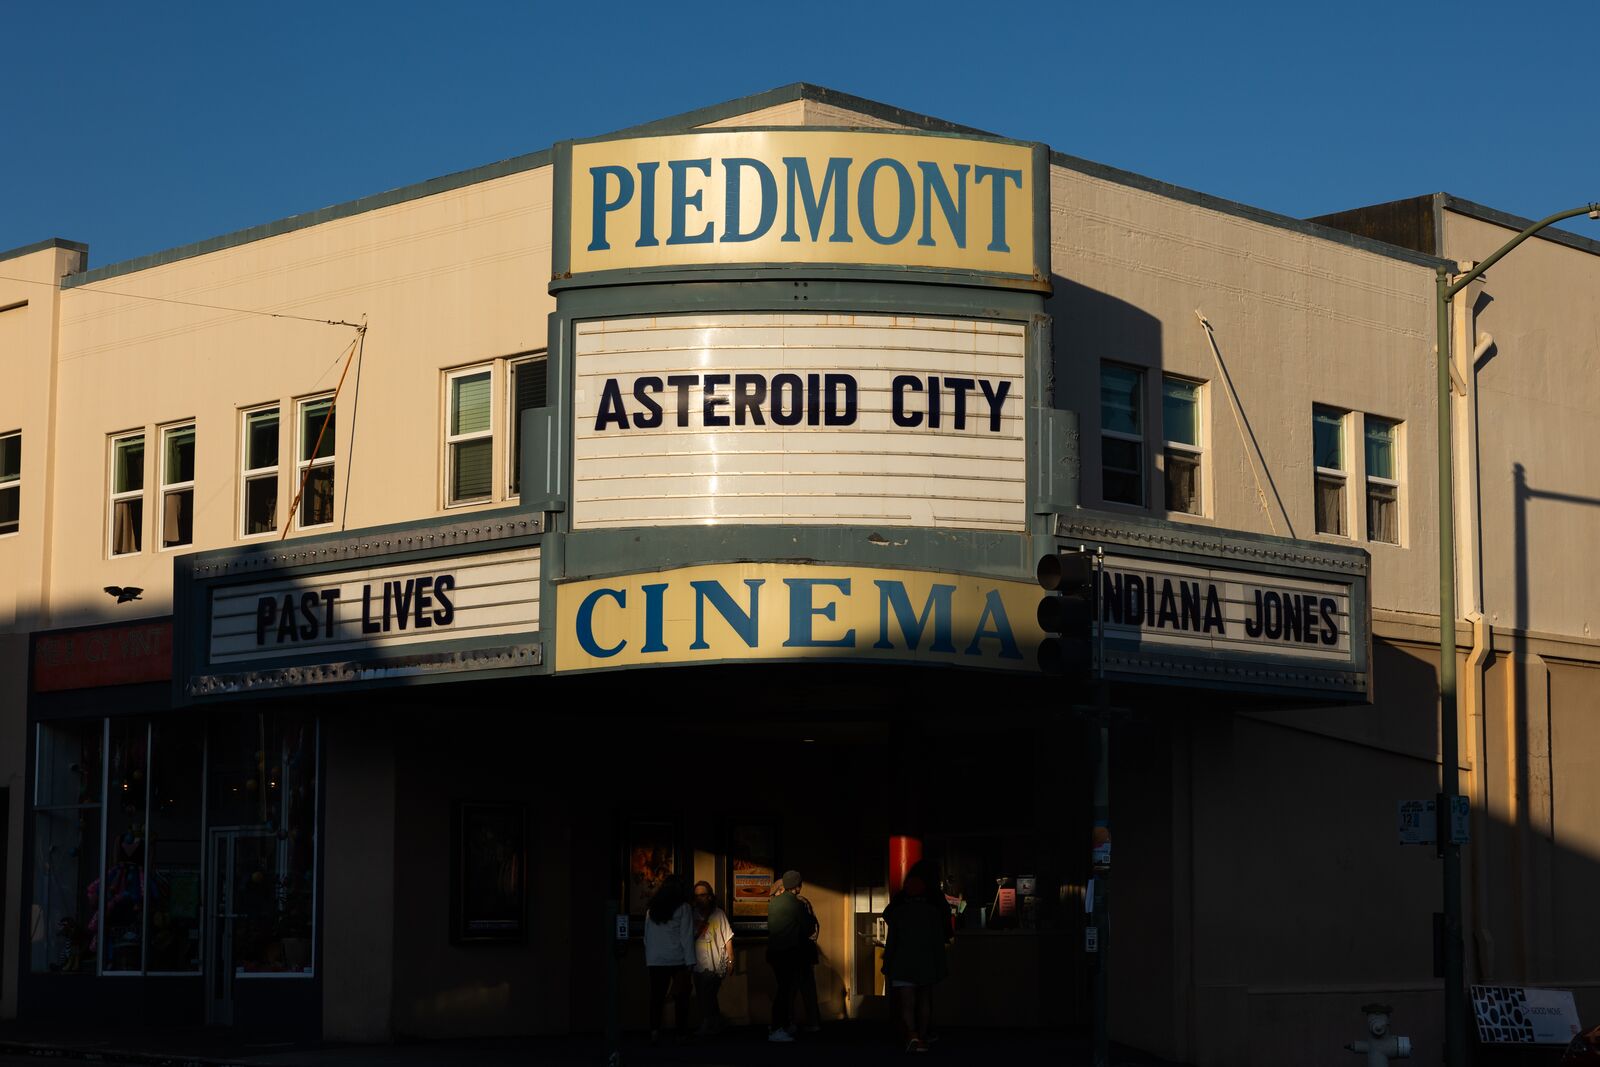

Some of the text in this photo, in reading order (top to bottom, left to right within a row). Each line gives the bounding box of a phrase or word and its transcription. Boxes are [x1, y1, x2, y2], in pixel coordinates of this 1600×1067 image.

[587, 156, 1022, 253] PIEDMONT
[594, 373, 1012, 432] ASTEROID CITY
[256, 574, 455, 645] PAST LIVES
[575, 577, 1024, 659] CINEMA
[1245, 589, 1338, 645] JONES
